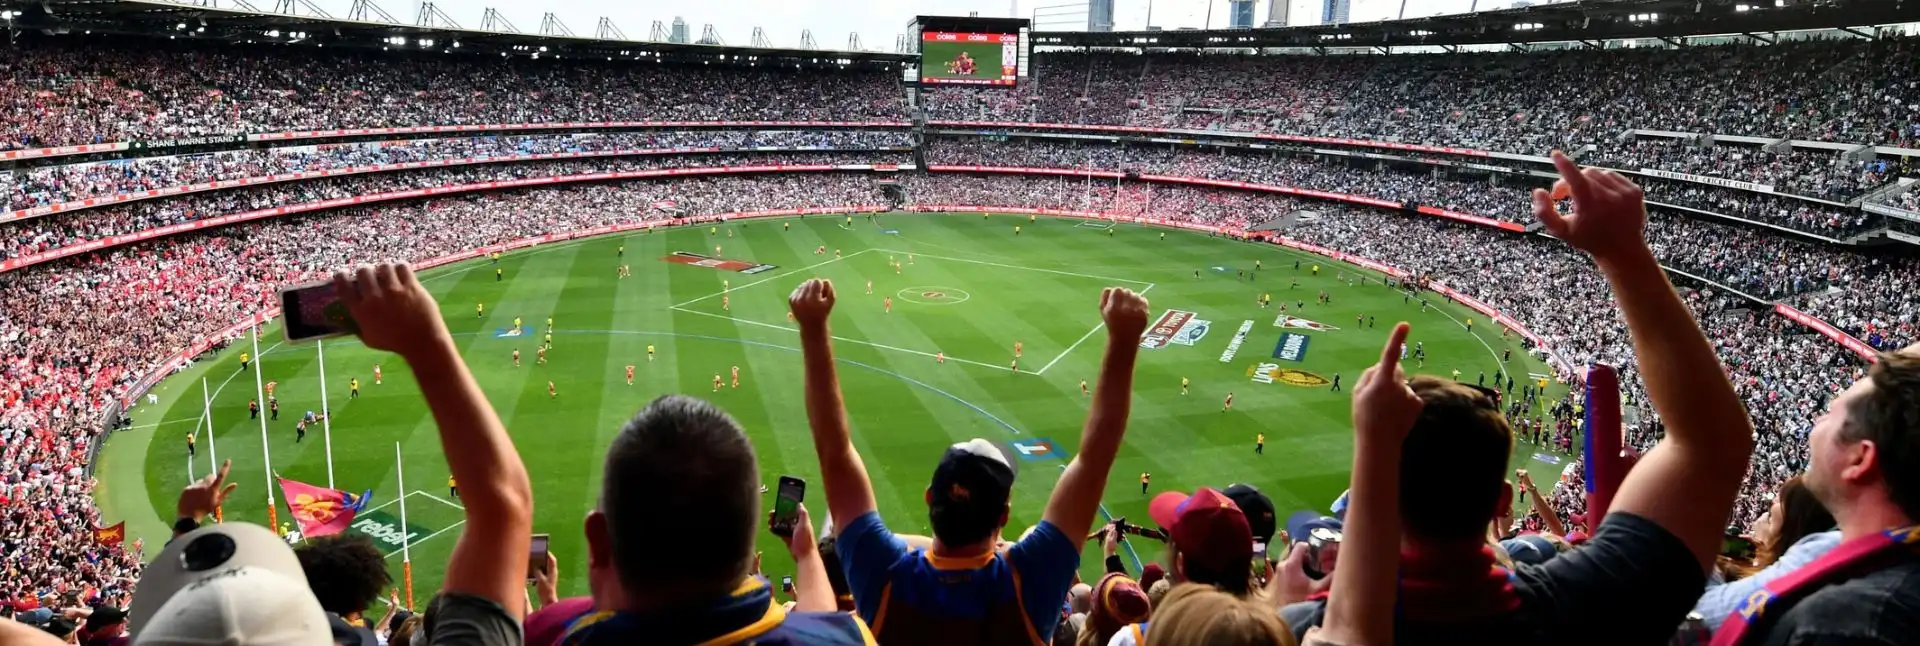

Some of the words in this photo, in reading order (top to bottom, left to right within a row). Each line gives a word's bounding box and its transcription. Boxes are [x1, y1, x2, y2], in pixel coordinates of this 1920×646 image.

[147, 139, 176, 148] SHANE
[177, 137, 206, 146] WARNE
[208, 135, 234, 144] STAND
[1656, 170, 1698, 182] MELBOURNE
[1702, 176, 1731, 186] CRICKET
[1734, 181, 1753, 189] CLUB
[350, 518, 419, 546] rebel
